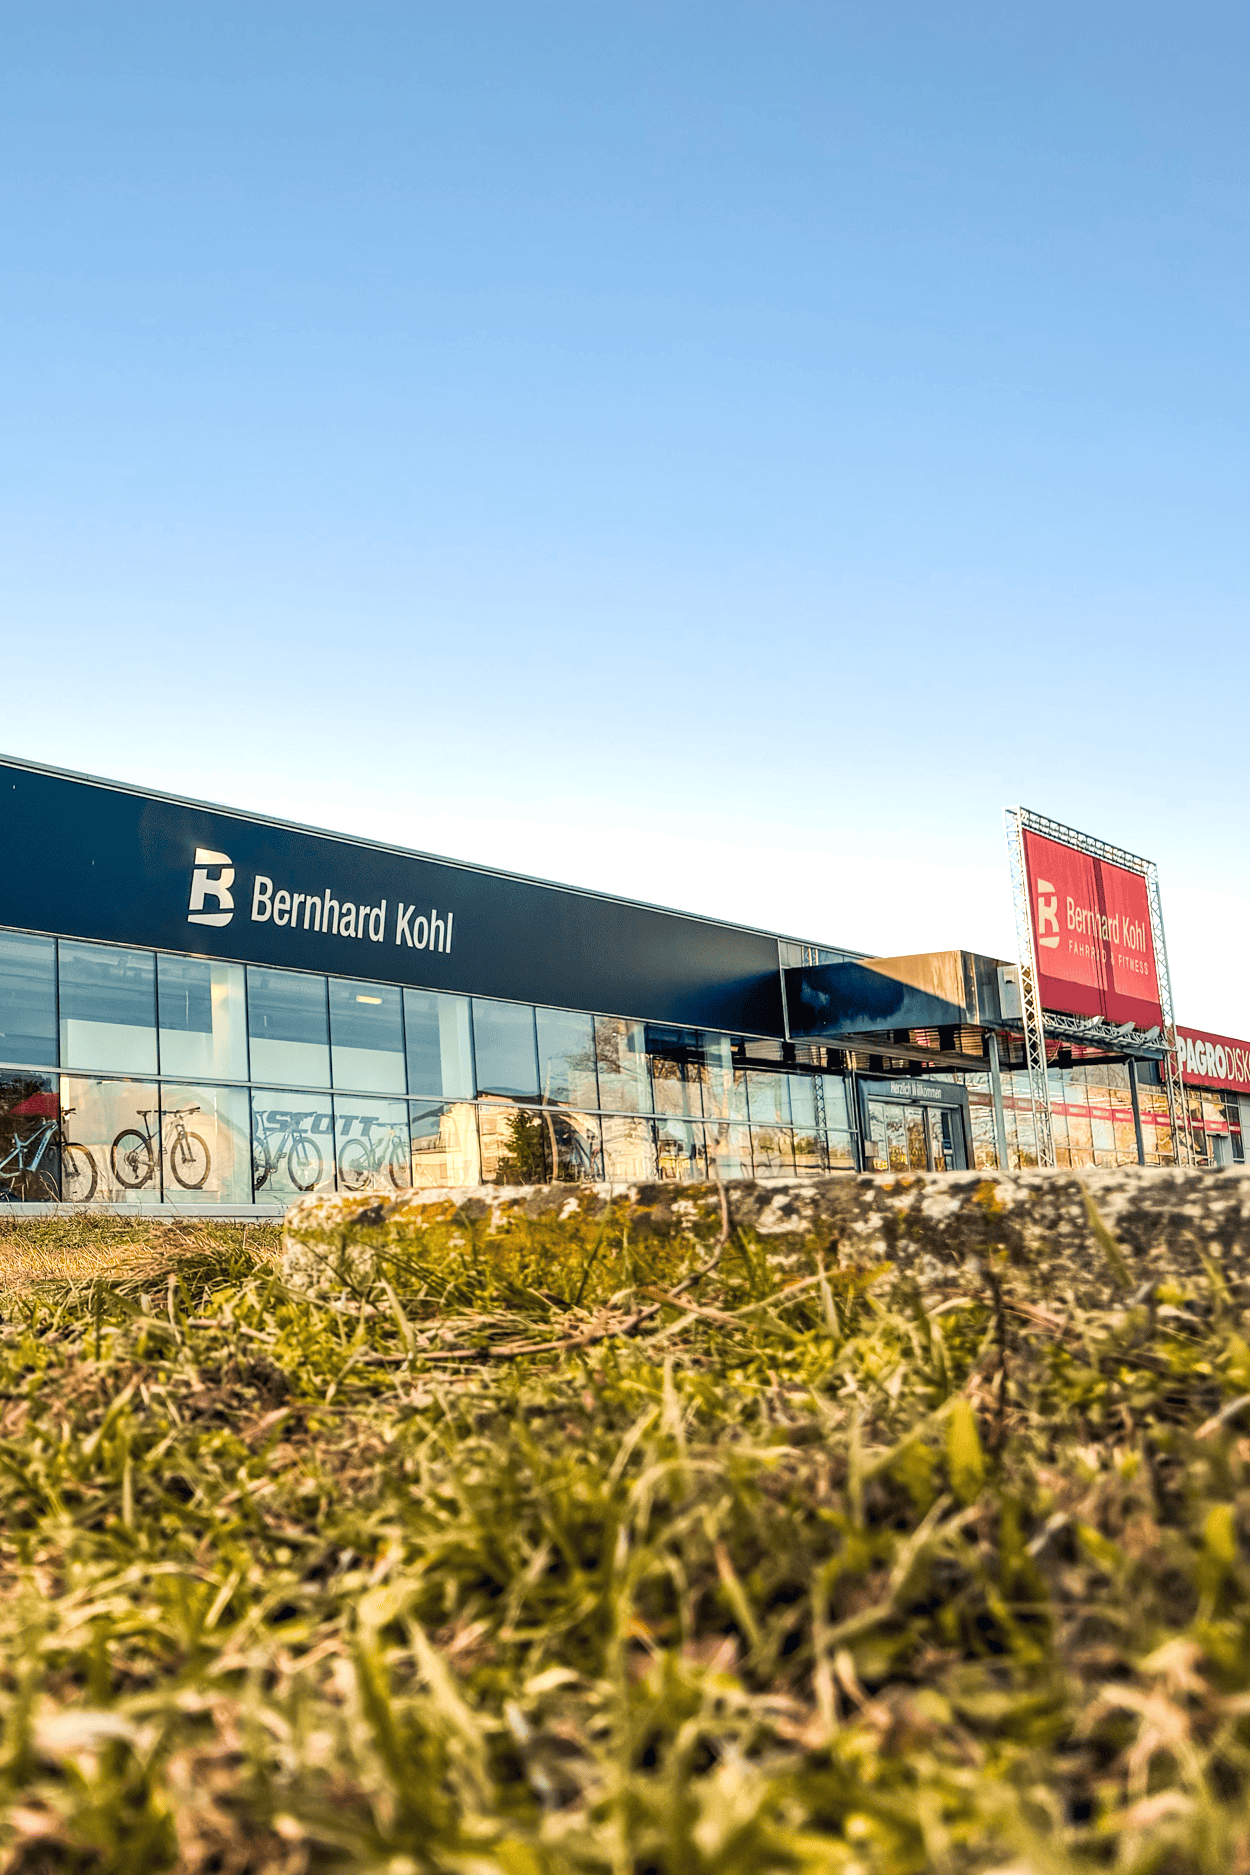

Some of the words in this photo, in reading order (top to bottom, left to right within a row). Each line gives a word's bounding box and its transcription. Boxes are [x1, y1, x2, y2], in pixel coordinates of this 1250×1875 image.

[251, 875, 387, 942] Bernhard
[395, 902, 454, 954] Kohl
[1066, 896, 1120, 945] Bernhard
[1122, 915, 1146, 954] Kohl
[1068, 939, 1107, 963] FAHRRAD
[1118, 954, 1149, 976] FITNESS
[1176, 1035, 1250, 1083] PAGRODISK
[264, 1110, 380, 1137] SCOTT
